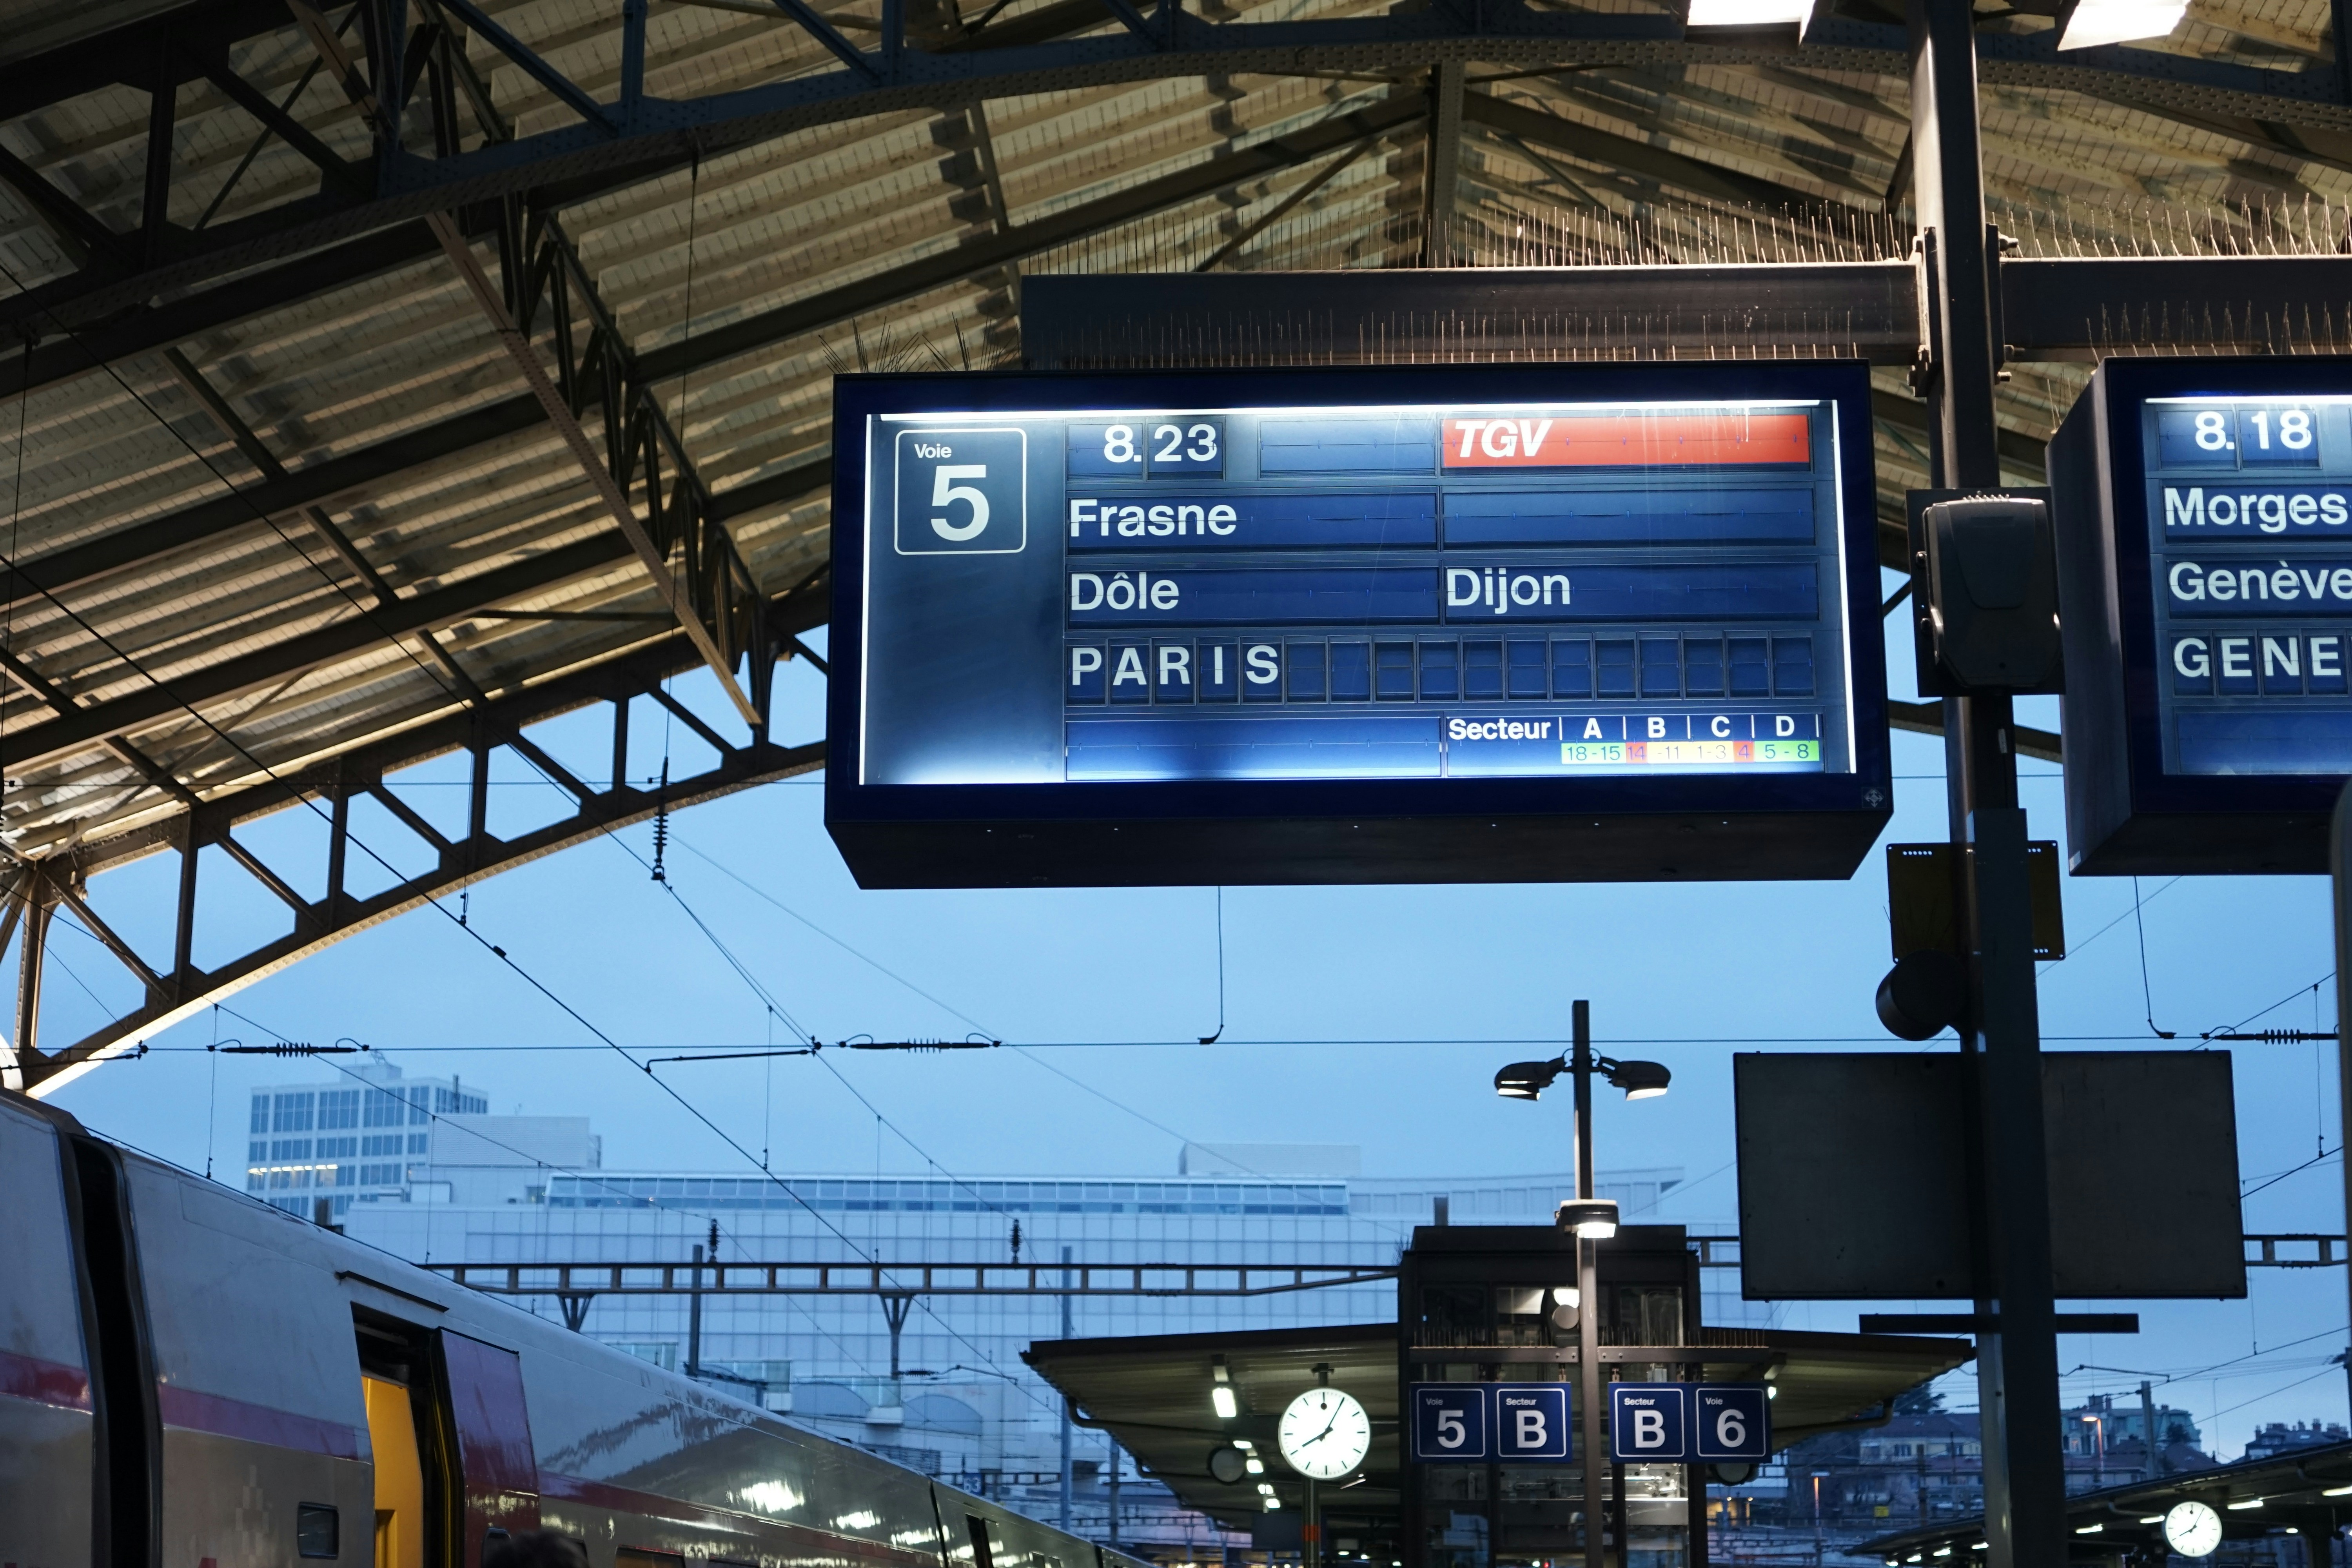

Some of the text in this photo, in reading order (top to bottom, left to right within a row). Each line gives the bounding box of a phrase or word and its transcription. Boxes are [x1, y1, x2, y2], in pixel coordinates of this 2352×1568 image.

[1103, 423, 1217, 463] 8.23
[1455, 419, 1553, 458] TGV
[2196, 411, 2312, 450] 8.18
[914, 443, 952, 458] Voie
[931, 465, 989, 541] 5
[1071, 499, 1237, 537] Frasne
[2165, 488, 2348, 533] Morges
[1071, 572, 1179, 610] Dôle
[1447, 568, 1570, 614] Dijon
[2169, 561, 2352, 601] Genève
[1072, 645, 1278, 686] PARIS
[2174, 636, 2352, 677] GENE
[1449, 715, 1795, 740] Secteur A B C D
[1738, 744, 1749, 759] 4
[1506, 1397, 1537, 1406] Secteur
[1624, 1397, 1655, 1406] Secteur
[1705, 1397, 1723, 1405] Voie
[1437, 1410, 1466, 1448] 5
[1516, 1410, 1547, 1448] B
[1634, 1410, 1665, 1448] B
[1717, 1409, 1746, 1448] 6
